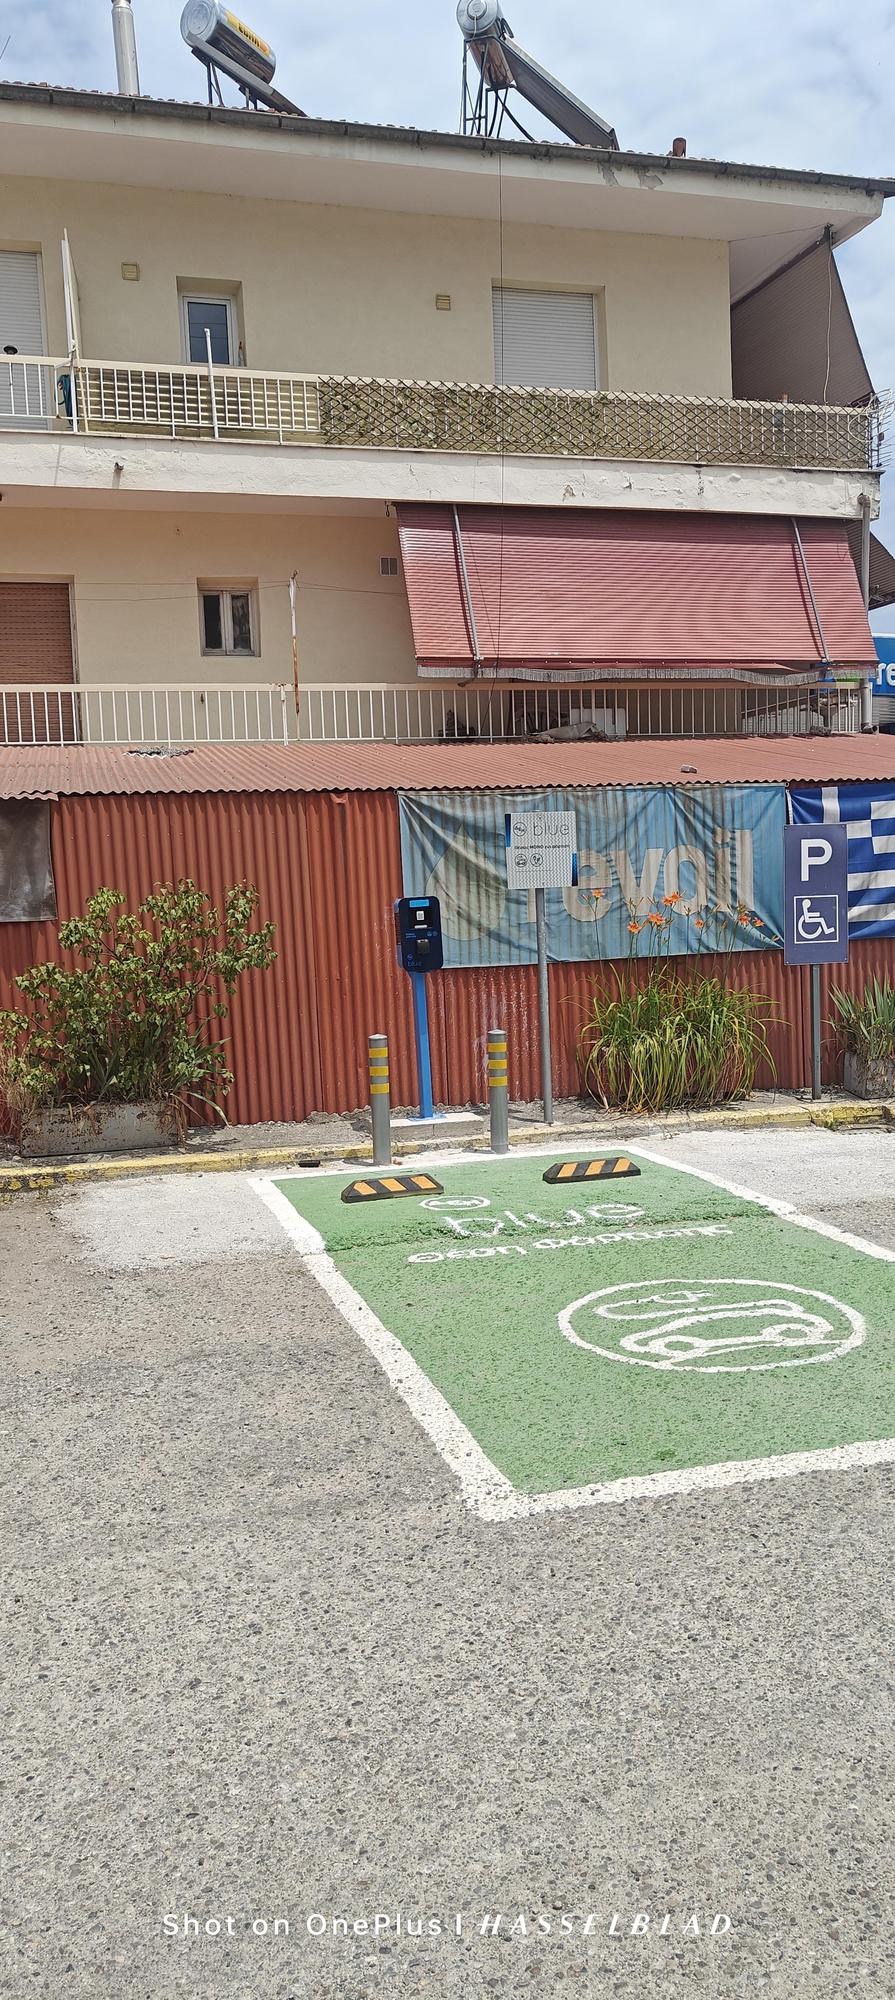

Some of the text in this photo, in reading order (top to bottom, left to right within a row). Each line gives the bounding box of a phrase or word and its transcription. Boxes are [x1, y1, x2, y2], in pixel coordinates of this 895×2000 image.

[533, 822, 569, 836] blue
[527, 827, 754, 923] evoil
[801, 838, 833, 882] P
[442, 1203, 646, 1238] blue
